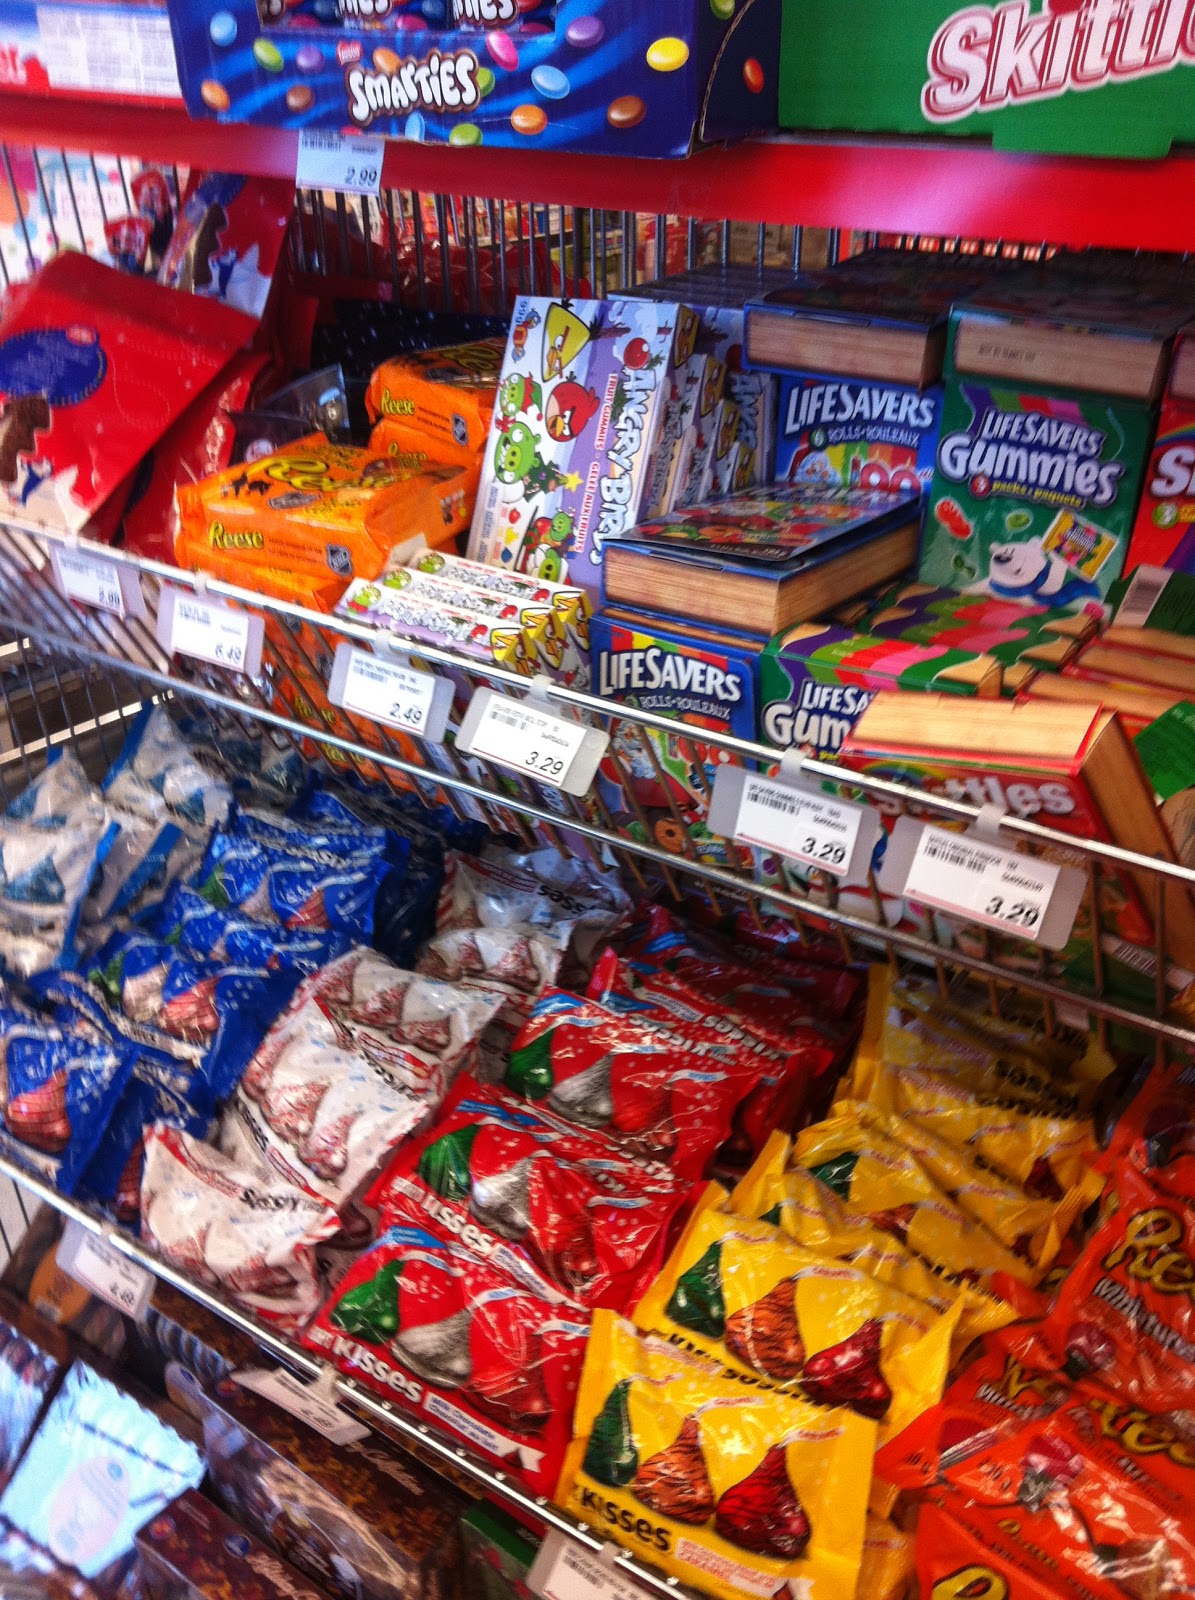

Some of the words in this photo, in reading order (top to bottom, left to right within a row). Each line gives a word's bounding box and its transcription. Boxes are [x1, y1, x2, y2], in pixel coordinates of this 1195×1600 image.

[925, 0, 1195, 119] Skittl
[350, 54, 477, 121] SMARTIES
[345, 166, 377, 187] 2.99
[381, 389, 415, 415] Reese
[606, 374, 618, 405] FRUIT
[595, 404, 613, 450] GUMMIES
[606, 364, 657, 471] ANGRY
[209, 520, 264, 550] Reese
[389, 702, 422, 724] 2.49
[802, 682, 874, 716] LIFESA
[525, 751, 563, 775] 3.29
[801, 836, 846, 865] 3.29
[985, 895, 1038, 928] 3.29
[333, 1335, 424, 1403] Kisses
